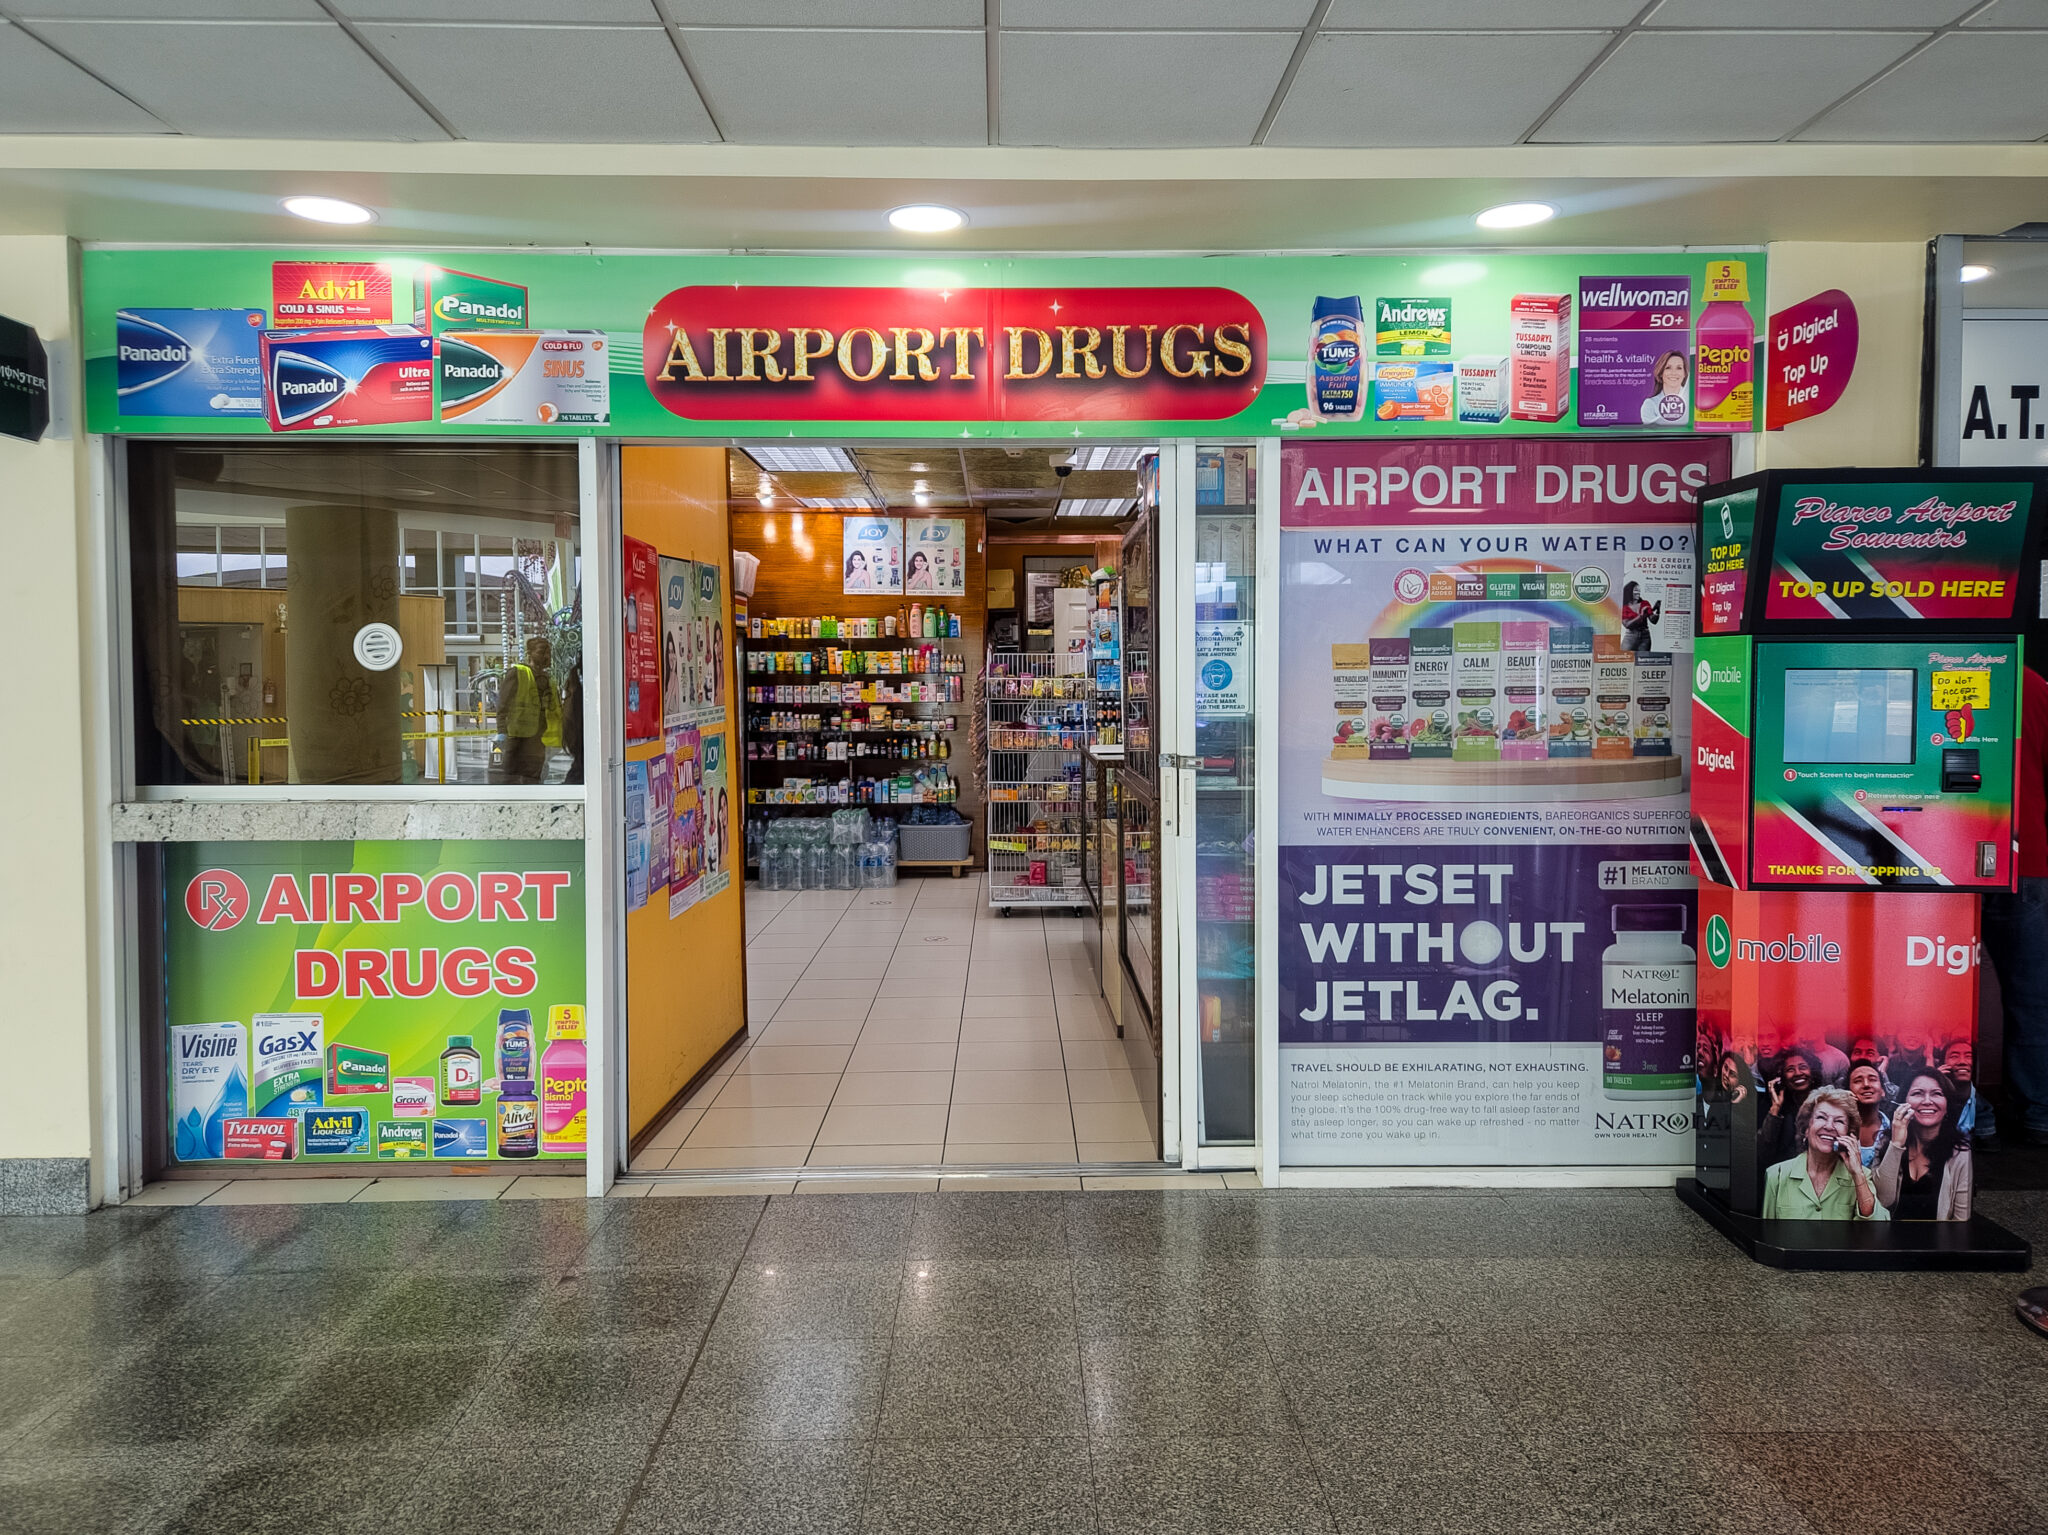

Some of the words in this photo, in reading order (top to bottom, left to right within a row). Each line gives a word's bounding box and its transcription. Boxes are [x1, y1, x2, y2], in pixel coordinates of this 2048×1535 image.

[1722, 266, 1731, 278] 5
[298, 279, 366, 301] Advil
[1581, 283, 1689, 307] wellwoman
[279, 305, 304, 314] COLD
[307, 305, 314, 314] &
[316, 305, 345, 314] SINUS
[442, 295, 523, 320] Panadol
[1380, 304, 1446, 323] Andrews
[1650, 314, 1684, 327] 50+
[1792, 309, 1839, 346] Digicel
[1516, 333, 1552, 343] TUSSADRYL
[120, 345, 187, 362] Panadol
[656, 327, 986, 382] AIRPORT
[1003, 323, 1252, 378] DRUGS
[1322, 348, 1356, 358] TUMS
[1516, 343, 1552, 351] COMPOUND
[1584, 354, 1615, 363] health
[1616, 354, 1623, 363] &
[1625, 354, 1655, 365] vitality
[1698, 345, 1751, 365] Pepto
[398, 367, 430, 379] Ultra
[444, 365, 499, 378] Panadol
[543, 360, 585, 378] SINUS
[1461, 369, 1496, 378] TUSSADRYL
[1698, 363, 1732, 374] Bismol
[1783, 365, 1806, 384] Top
[1810, 355, 1829, 376] Up
[281, 378, 338, 396] Panadol
[1329, 381, 1347, 389] Fruit
[1788, 384, 1819, 407] Here
[1294, 464, 1516, 507] AIRPORT
[1535, 462, 1710, 505] DRUGS
[1793, 496, 1892, 526] Piarco
[1896, 496, 2017, 528] Airport
[861, 528, 885, 538] JOY
[1822, 525, 1967, 551] Souvenirs
[1314, 538, 1383, 555] WHAT
[1395, 537, 1445, 554] CAN
[1459, 537, 1529, 553] YOUR
[1542, 536, 1627, 552] WATER
[1641, 534, 1690, 552] DO?
[1711, 547, 1726, 560] TOP
[1728, 545, 1741, 557] UP
[632, 553, 646, 574] Kure
[1708, 562, 1724, 573] SOLD
[1726, 559, 1744, 570] HERE
[701, 576, 713, 593] JOY
[1581, 575, 1602, 584] USDA
[669, 586, 683, 601] JOY
[1489, 583, 1516, 591] GLUTEN
[1522, 583, 1545, 591] VEGAN
[1716, 581, 1735, 595] Digicel
[1779, 581, 1826, 598] TOP
[1832, 581, 1864, 597] UP
[1870, 581, 1935, 597] SOLD
[1941, 581, 2005, 597] HERE
[1714, 614, 1728, 624] Here
[1415, 662, 1449, 672] ENERGY
[1463, 657, 1489, 668] CALM
[1551, 659, 1591, 669] DIGESTION
[1372, 670, 1408, 679] IMMUNITY
[1600, 668, 1627, 677] FOCUS
[1641, 671, 1667, 679] SLEEP
[1712, 668, 1741, 684] mobile
[1956, 676, 1973, 684] NOT
[1943, 687, 1978, 695] ACCEPT
[706, 747, 718, 764] JOY
[1697, 746, 1734, 771] Digicel
[1304, 812, 1331, 822] WITH
[1333, 812, 1393, 821] MINIMALLY
[1396, 811, 1463, 821] PROCESSED
[1465, 811, 1542, 822] INGREDIENTS,
[1545, 811, 1631, 821] BAREORGANICS
[1633, 810, 1691, 820] SUPERFOO
[1317, 827, 1354, 836] WATER
[1355, 827, 1421, 836] ENHANCERS
[1423, 827, 1446, 836] ARE
[1447, 827, 1481, 836] TRULY
[1483, 827, 1557, 837] CONVENIENT,
[1559, 826, 1623, 836] ON-THE-GO
[1626, 826, 1686, 835] NUTRITION
[1768, 865, 1826, 876] THANKS
[1828, 866, 1856, 876] FOR
[1860, 866, 1921, 877] TOPPING
[1923, 867, 1941, 877] UP
[1299, 864, 1514, 905] JETSET
[257, 871, 571, 924] AIRPORT
[1299, 920, 1585, 964] WITHOUT
[1737, 933, 1840, 963] mobile
[294, 946, 538, 999] DRUGS
[1622, 969, 1680, 981] NATROL
[1299, 980, 1539, 1022] JETLAG.
[1611, 988, 1690, 1005] Melatonin
[563, 1009, 571, 1020] 5
[1635, 1012, 1664, 1022] SLEEP
[181, 1033, 238, 1058] Visine
[259, 1031, 317, 1056] Gas-X
[505, 1040, 528, 1048] TUMS
[202, 1066, 219, 1074] EYE
[342, 1061, 386, 1073] Panadol
[1291, 1063, 1333, 1072] TRAVEL
[1336, 1063, 1382, 1072] SHOULD
[1384, 1063, 1399, 1072] BE
[1402, 1063, 1486, 1073] EXHILARATING,
[1489, 1063, 1512, 1072] NOT
[1515, 1063, 1589, 1072] EXHAUSTING.
[273, 1072, 300, 1087] EXTRA
[1322, 1081, 1370, 1091] Melatonin,
[1457, 1081, 1488, 1091] Brand,
[1513, 1081, 1533, 1091] help
[1537, 1083, 1553, 1091] you
[1557, 1081, 1580, 1091] keep
[395, 1096, 427, 1104] Gravol
[544, 1093, 574, 1101] Bismol
[287, 1108, 300, 1116] 48
[503, 1109, 535, 1125] Alive!
[227, 1122, 286, 1136] TYLENOL
[312, 1116, 353, 1129] Advil
[312, 1128, 353, 1136] LIQUI-GELS
[381, 1126, 423, 1138] Andrews
